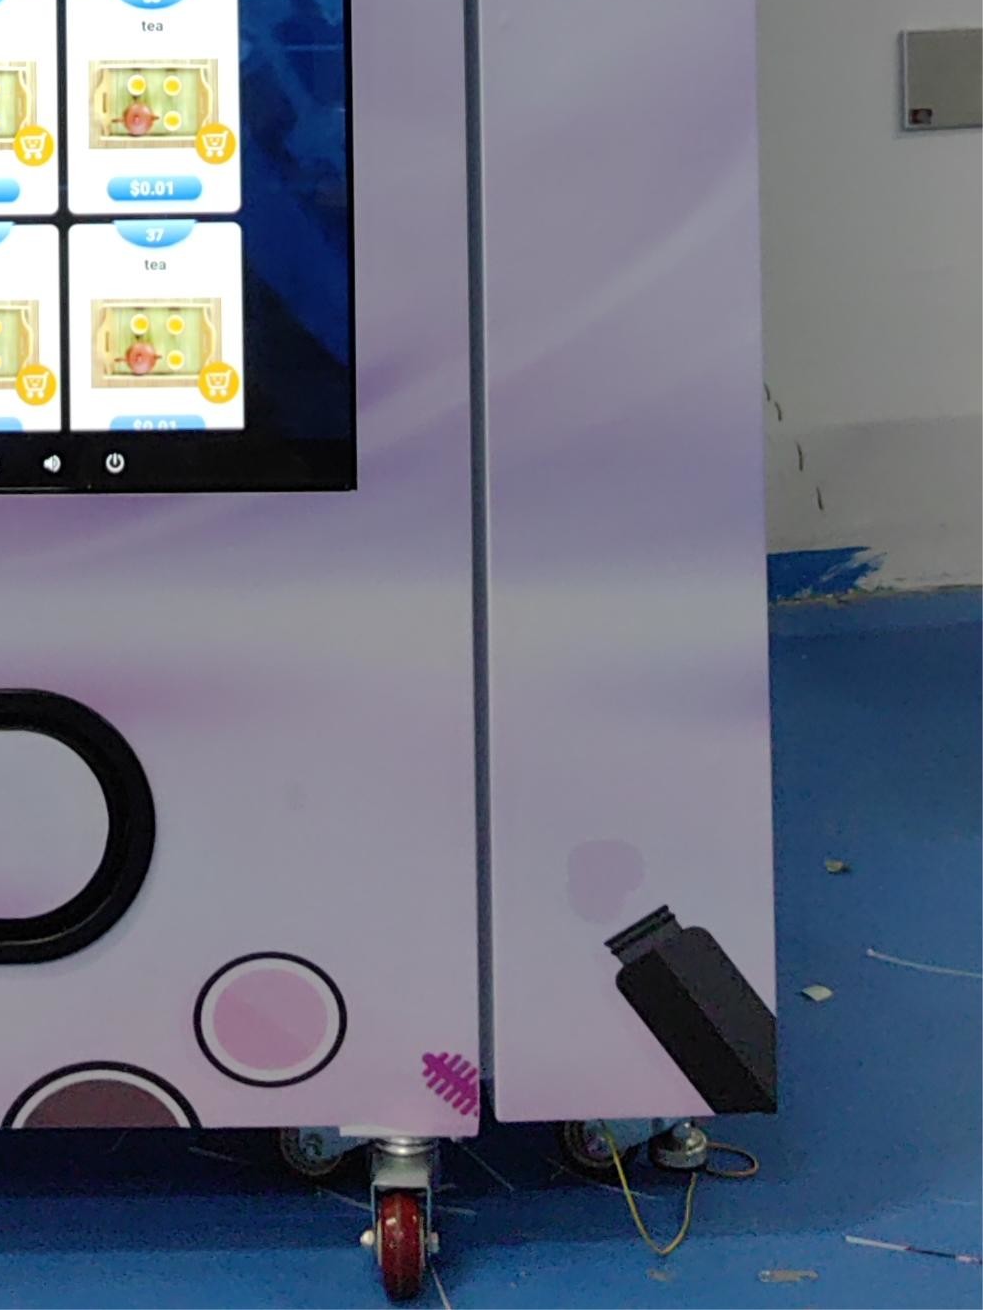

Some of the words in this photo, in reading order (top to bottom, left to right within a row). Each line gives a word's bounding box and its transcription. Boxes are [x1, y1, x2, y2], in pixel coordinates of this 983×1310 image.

[142, 21, 163, 32] tea
[130, 180, 174, 198] $0.01
[146, 229, 163, 242] 37
[145, 259, 166, 271] tea
[134, 420, 176, 429] $001
